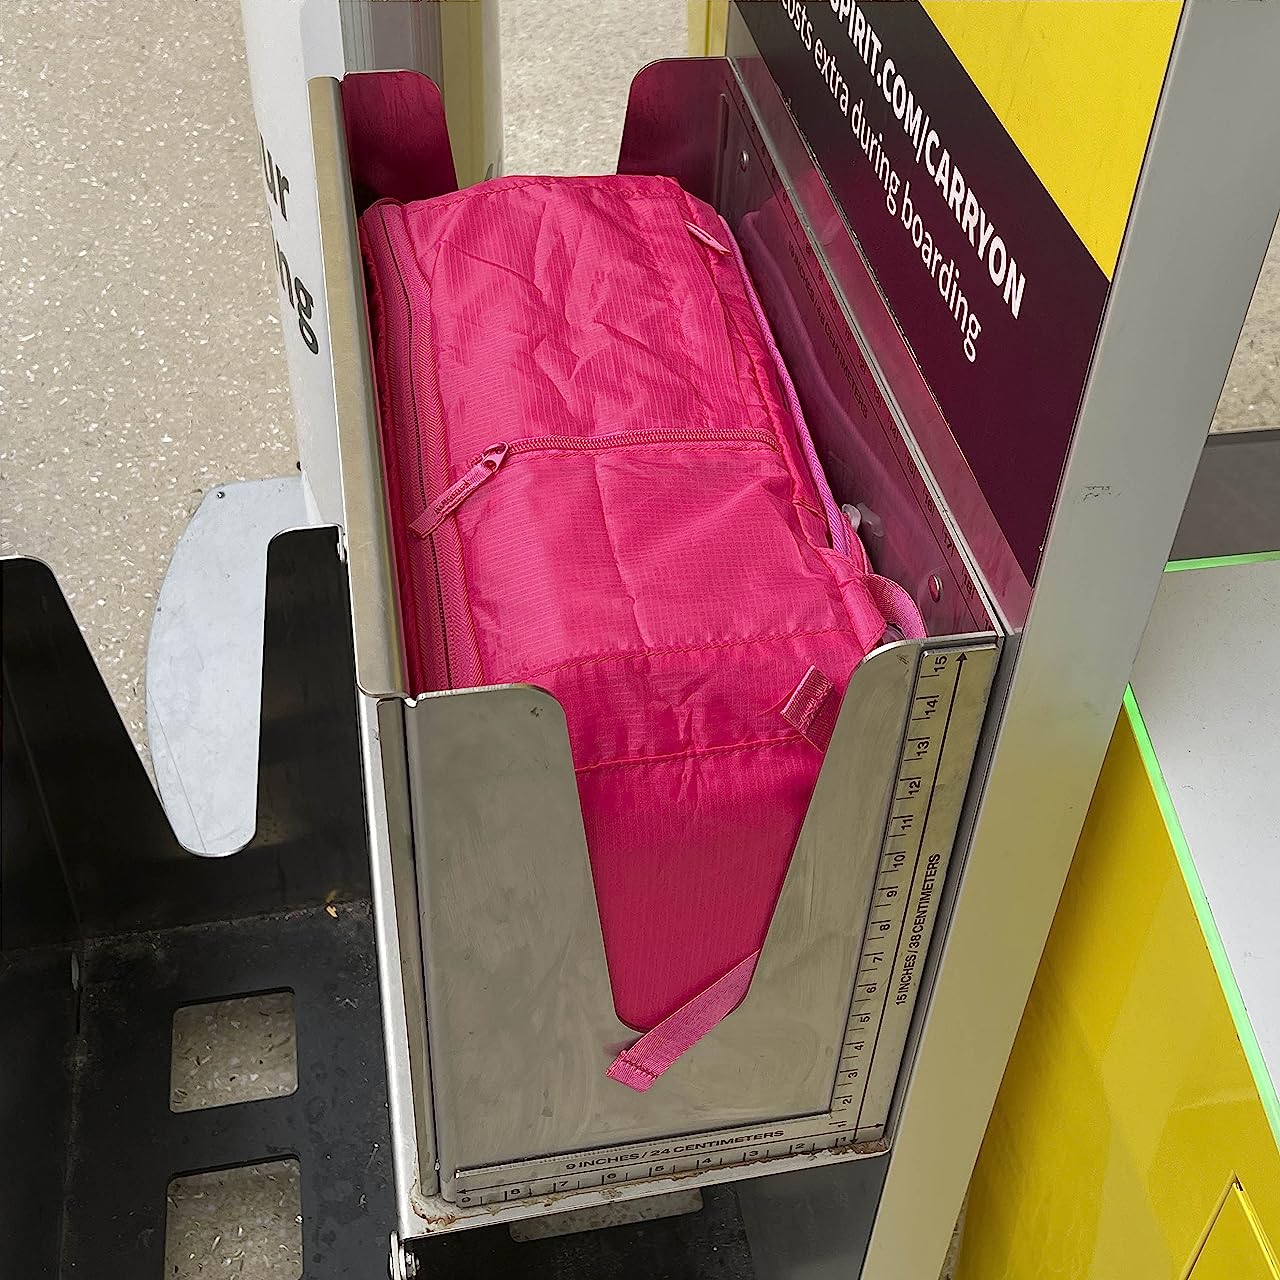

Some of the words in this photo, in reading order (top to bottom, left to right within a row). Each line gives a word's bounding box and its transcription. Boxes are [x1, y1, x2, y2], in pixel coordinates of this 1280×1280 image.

[814, 38, 850, 117] extra
[851, 98, 901, 216] during
[901, 180, 982, 363] boarding
[933, 655, 947, 672] 15
[924, 699, 939, 715] 14
[916, 740, 930, 756] 13
[908, 780, 921, 796] 12
[901, 817, 913, 830] 11
[893, 855, 906, 869] 10
[912, 853, 941, 933] CENTIMETERS
[909, 933, 922, 949] 38
[898, 954, 917, 995] INCHES
[896, 994, 907, 1005] 15
[579, 1152, 640, 1168] INCHES
[649, 1147, 671, 1157] 24
[673, 1130, 785, 1154] CENTIMETERS
